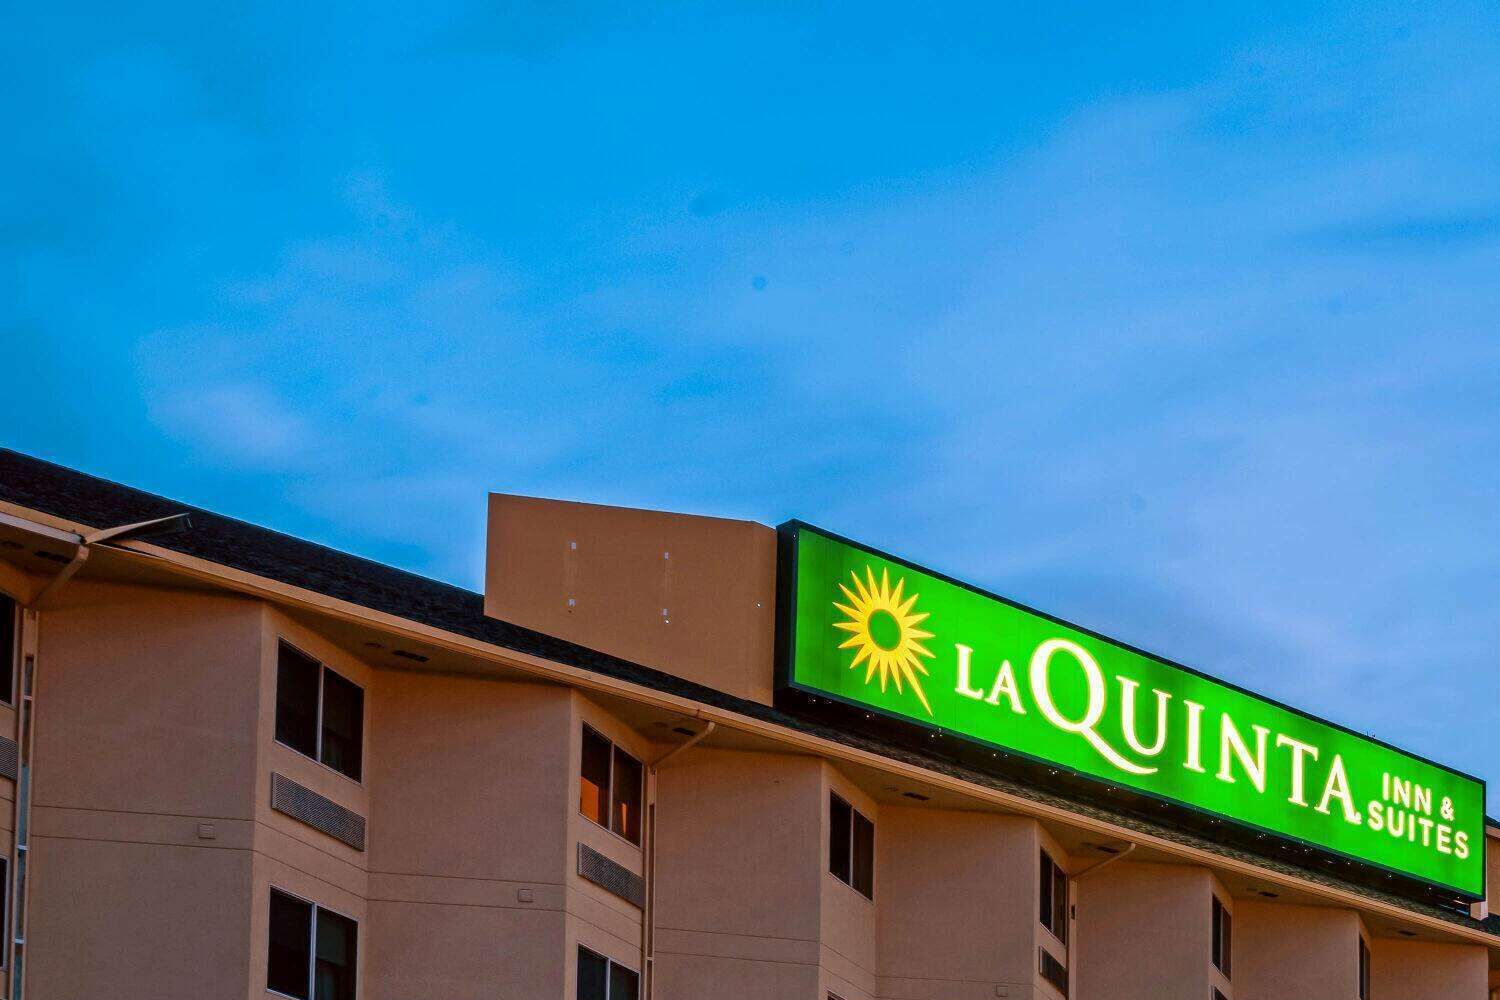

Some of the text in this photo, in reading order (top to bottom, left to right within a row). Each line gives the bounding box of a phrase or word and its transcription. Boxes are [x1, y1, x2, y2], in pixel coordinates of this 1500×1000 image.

[955, 637, 1361, 825] LA QUINTA
[1382, 772, 1455, 822] INN &
[1367, 800, 1470, 860] SUITES
